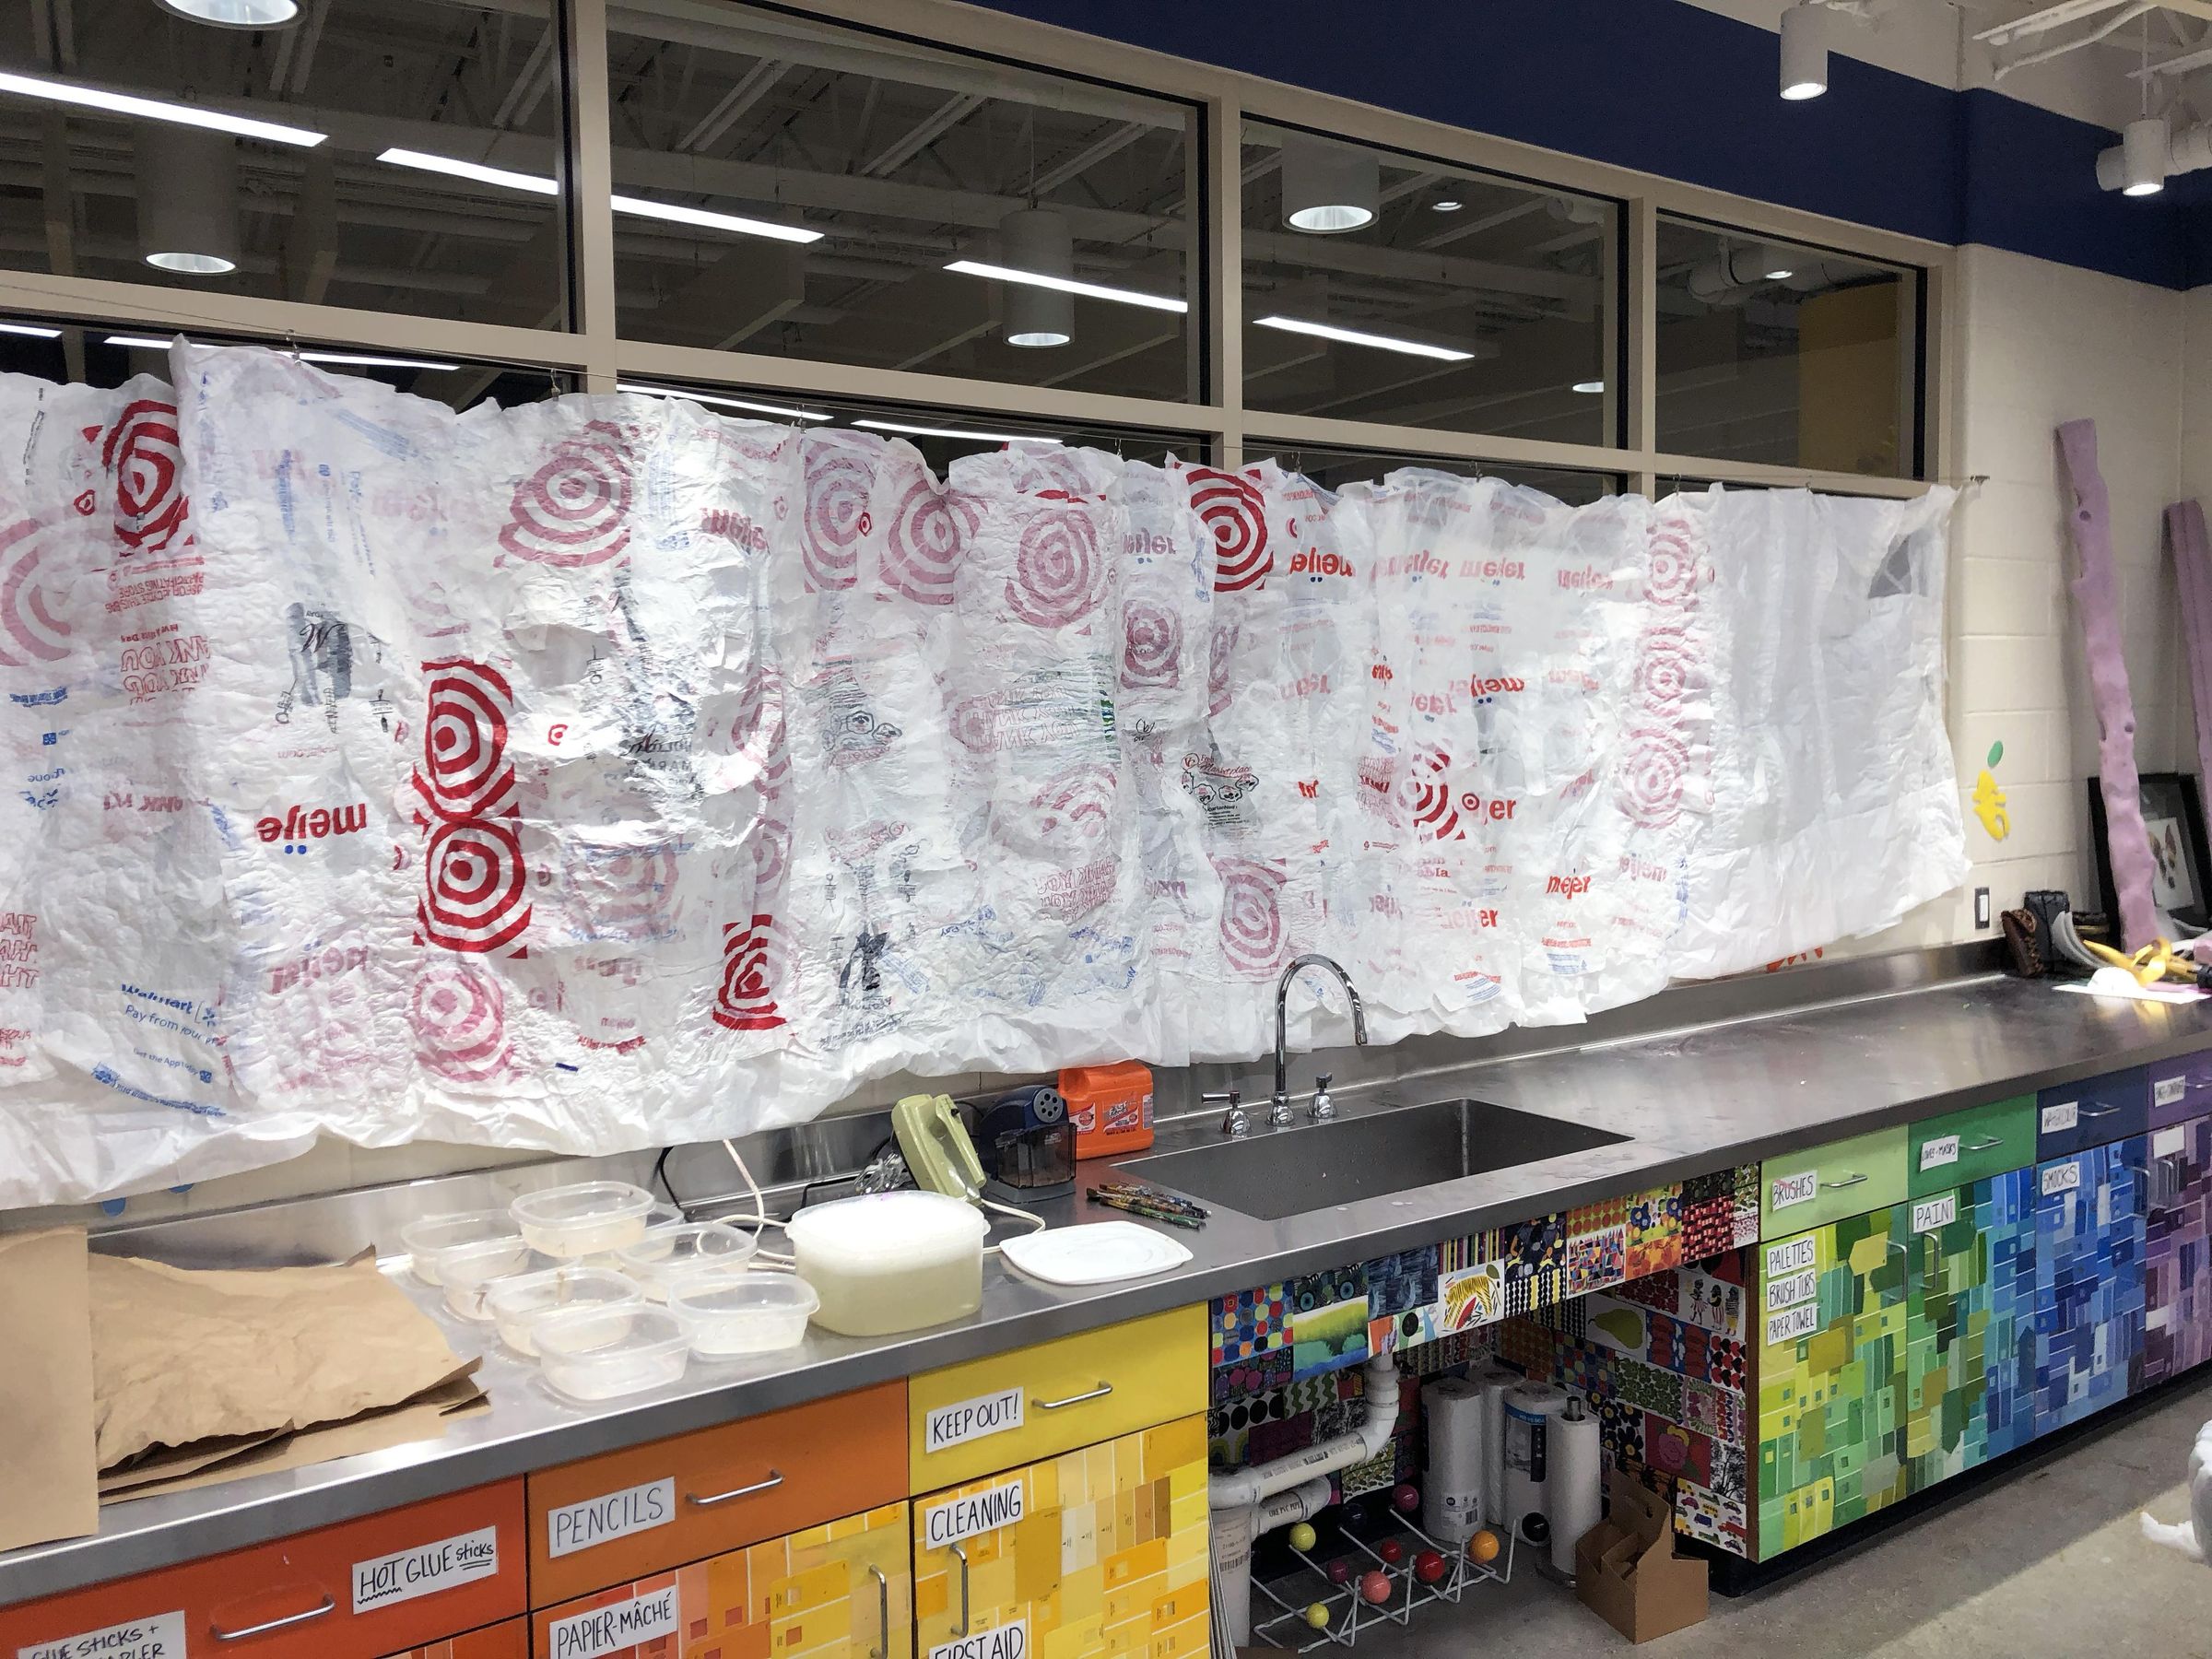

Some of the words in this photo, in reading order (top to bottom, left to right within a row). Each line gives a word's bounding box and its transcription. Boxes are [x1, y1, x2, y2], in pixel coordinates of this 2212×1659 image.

[255, 804, 367, 854] meije
[124, 1004, 147, 1022] Pay
[149, 1013, 178, 1030] from
[1109, 1100, 1128, 1117] FAST
[1773, 1175, 1814, 1206] BRUSHES
[2043, 1165, 2078, 1192] SMOCKS
[1917, 1198, 1954, 1229] PAINT
[1770, 1241, 1814, 1274] PALETTES
[1770, 1278, 1795, 1308] BRUSH
[1796, 1272, 1815, 1300] TUBS
[1770, 1315, 1790, 1342] PAPER
[1792, 1308, 1815, 1334] TOWEL
[934, 1407, 973, 1444] KEEP
[977, 1393, 1018, 1429] OUT!
[557, 1487, 664, 1547] PENCILS
[931, 1485, 1022, 1542] CLEANING
[360, 1558, 406, 1596] HOT
[406, 1544, 454, 1583] GLUE
[455, 1540, 494, 1561] sticks
[148, 1625, 159, 1635] +
[558, 1592, 672, 1659] PAPIER-MÂCHÉ
